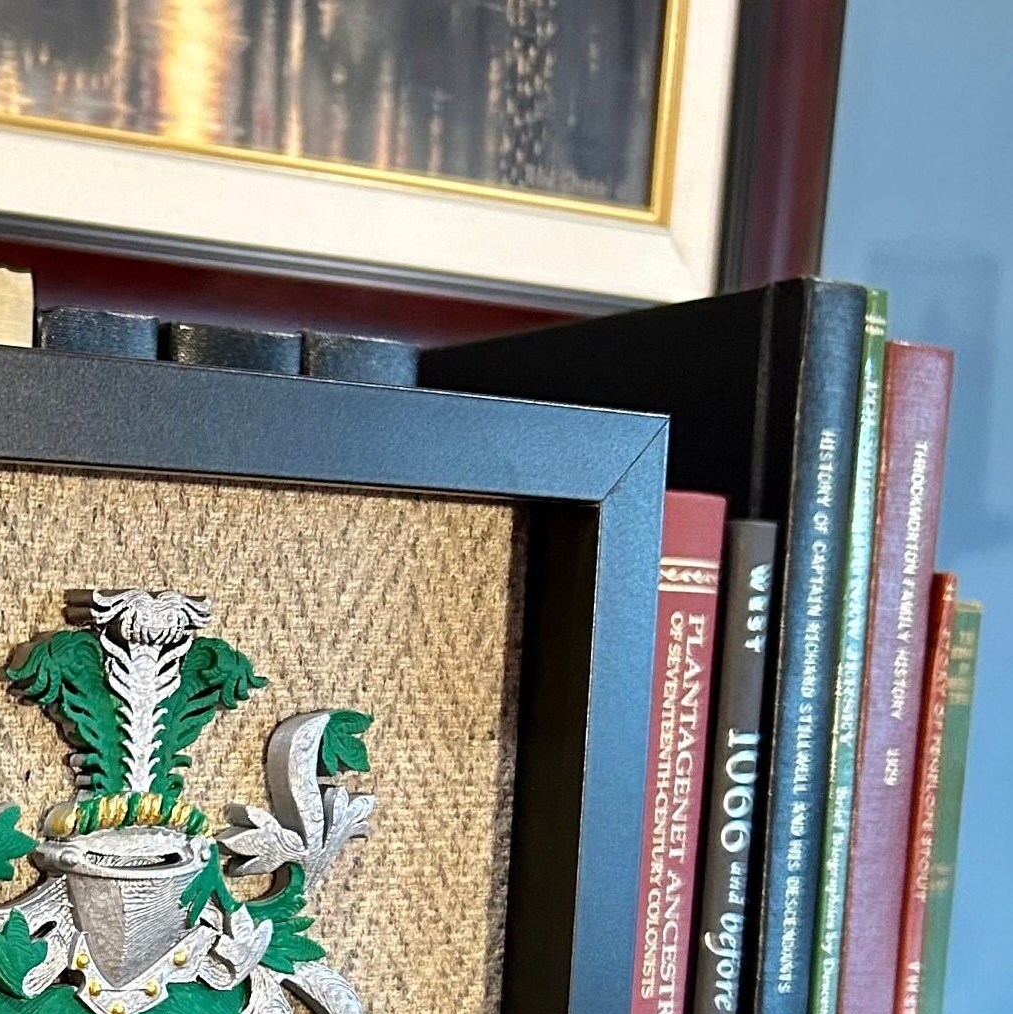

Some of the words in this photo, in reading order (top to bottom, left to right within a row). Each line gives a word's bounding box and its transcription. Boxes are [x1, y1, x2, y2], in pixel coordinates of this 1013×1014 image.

[816, 428, 837, 507] HISTORY
[813, 511, 829, 534] OF
[903, 441, 929, 574] THROCKMORTON
[744, 563, 772, 653] WEST
[806, 540, 827, 617] CAPTAIN
[897, 578, 916, 643] FAMILY
[670, 610, 684, 642] OF
[801, 621, 822, 698] RICHARD
[839, 644, 863, 747] JERSEY
[890, 649, 911, 720] HISTORY
[649, 641, 682, 887] SEVENTEENTH-CENTURY
[668, 613, 706, 864] PLANTAGENET
[793, 702, 813, 795] STILLWELL
[721, 727, 761, 853] 1066
[790, 799, 808, 836] AND
[832, 786, 854, 828] Brief
[728, 861, 747, 906] and
[787, 838, 804, 871] HIS
[824, 831, 846, 930] Biographies
[914, 833, 934, 904] STOUT
[640, 887, 661, 999] COLONISTS
[704, 912, 745, 1012] before
[778, 876, 800, 994] DESCENDANTS
[820, 931, 837, 956] by
